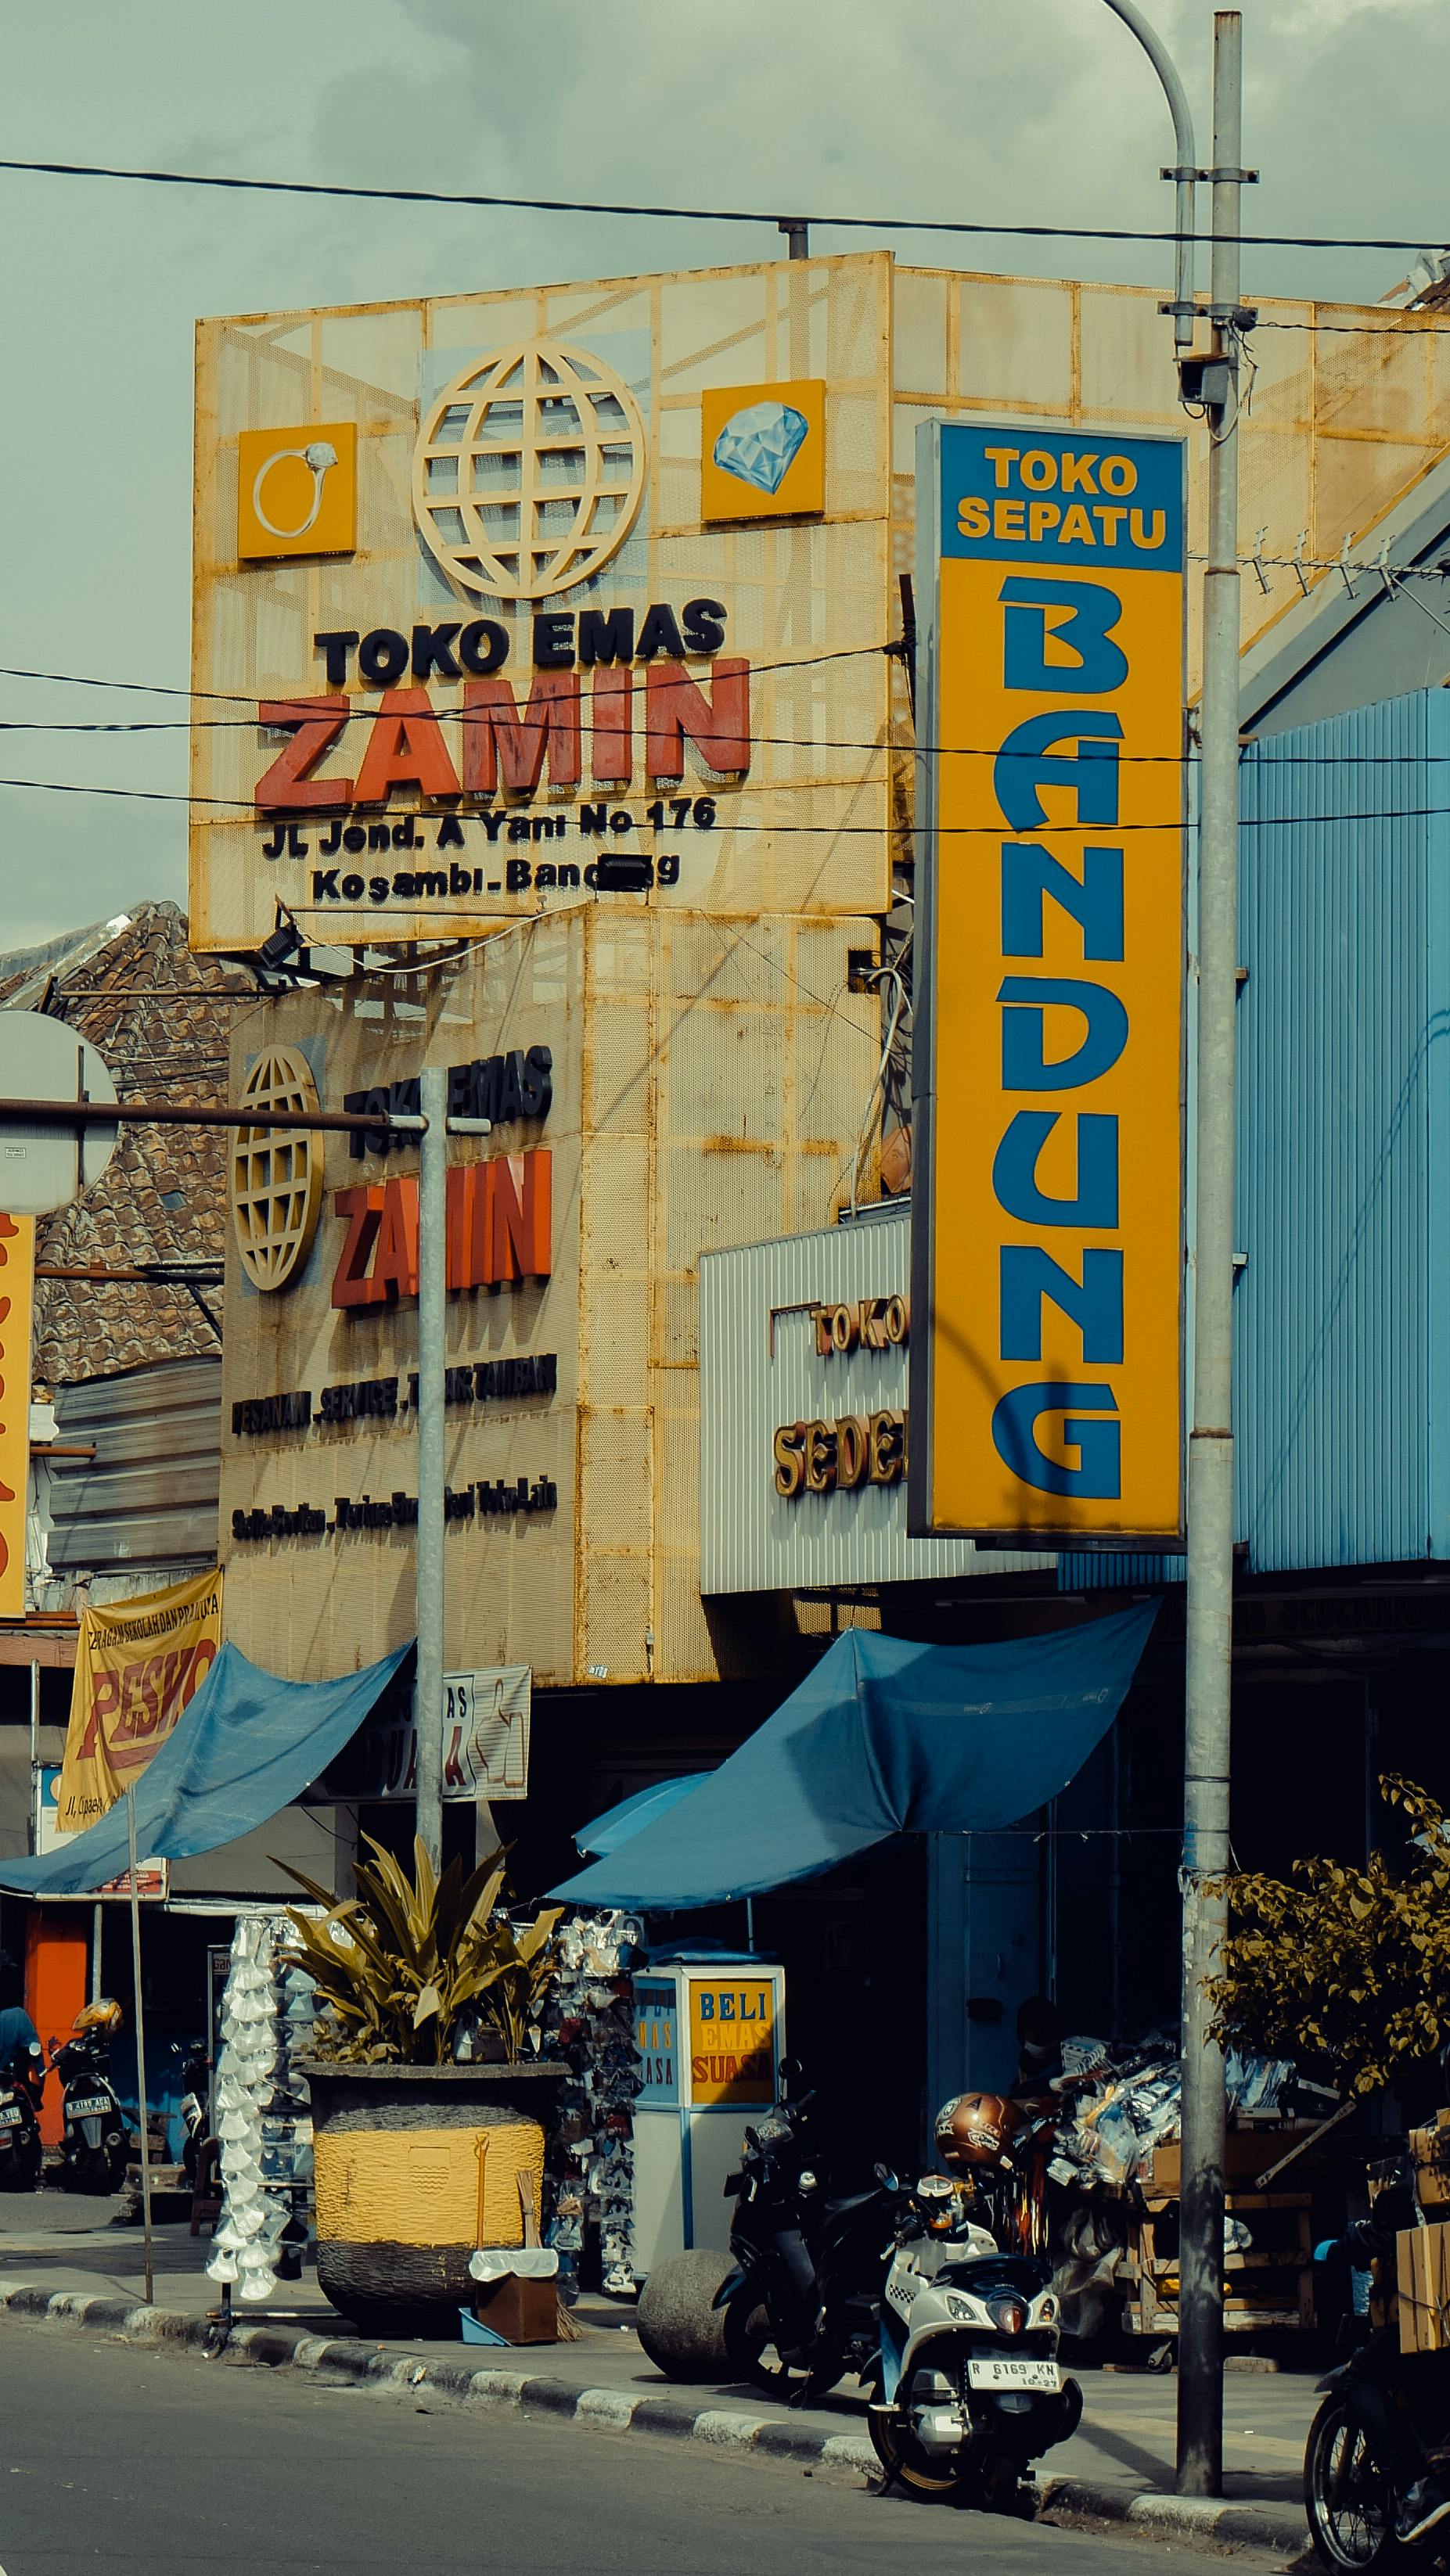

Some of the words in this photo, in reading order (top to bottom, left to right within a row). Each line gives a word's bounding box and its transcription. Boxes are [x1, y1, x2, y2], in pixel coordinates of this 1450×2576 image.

[984, 447, 1138, 497] TOKO
[957, 496, 1167, 549] SEPATU
[314, 618, 509, 684] TOKO
[533, 598, 729, 666] EMAS
[255, 658, 750, 811] ZAMIN
[318, 814, 425, 853] Jend.
[436, 813, 466, 846] A
[478, 810, 566, 842] Yani
[580, 803, 633, 834] No
[647, 796, 717, 831] 176
[991, 576, 1129, 1501] BANDUNG
[448, 1045, 553, 1125] EMAS
[809, 1293, 908, 1356] TOKO
[124, 1614, 160, 1642] SEKOLAH
[160, 1608, 178, 1633] DAN
[700, 1992, 766, 2021] BELI
[700, 2021, 772, 2052] EMAS
[693, 2053, 773, 2085] SUASA
[971, 2362, 980, 2375] R
[993, 2363, 1027, 2375] 6169
[1036, 2363, 1054, 2377] KN
